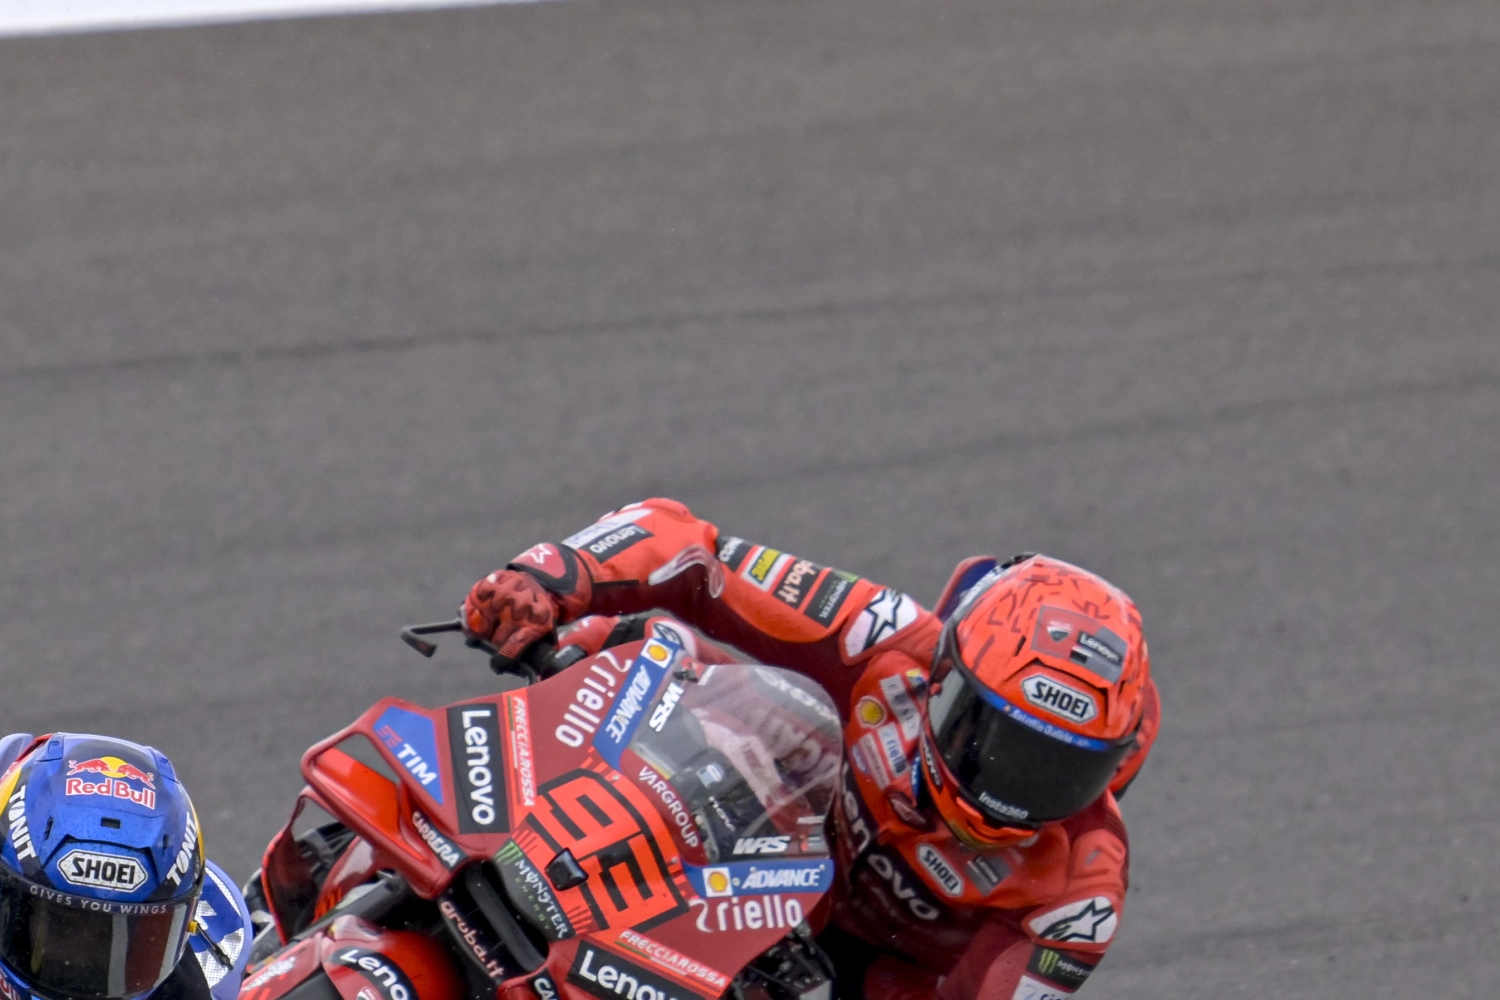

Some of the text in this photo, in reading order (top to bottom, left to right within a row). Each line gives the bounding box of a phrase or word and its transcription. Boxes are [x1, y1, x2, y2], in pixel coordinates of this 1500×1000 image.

[555, 664, 616, 748] riello
[606, 665, 652, 744] ADVANCE
[649, 682, 684, 732] WRS
[1032, 680, 1089, 719] SHOEI
[397, 743, 437, 786] TIM
[462, 710, 496, 826] Lenovo
[514, 696, 536, 807] FRECCIAROSSA
[65, 778, 156, 809] Red Bull
[639, 766, 699, 848] VARGROUP
[978, 791, 1029, 820] Insta360
[412, 811, 460, 869] CARRERA
[524, 768, 690, 934] 93
[732, 836, 791, 855] WRS
[71, 857, 136, 885] SHOEI
[740, 868, 820, 889] ADVANCE
[924, 849, 960, 892] SHOEI
[29, 884, 167, 915] GIVES YOU WINGS
[515, 859, 569, 939] MONSTER
[716, 895, 803, 932] riello
[440, 901, 505, 979] aruba.it
[619, 930, 726, 988] FRECCIAROSSA
